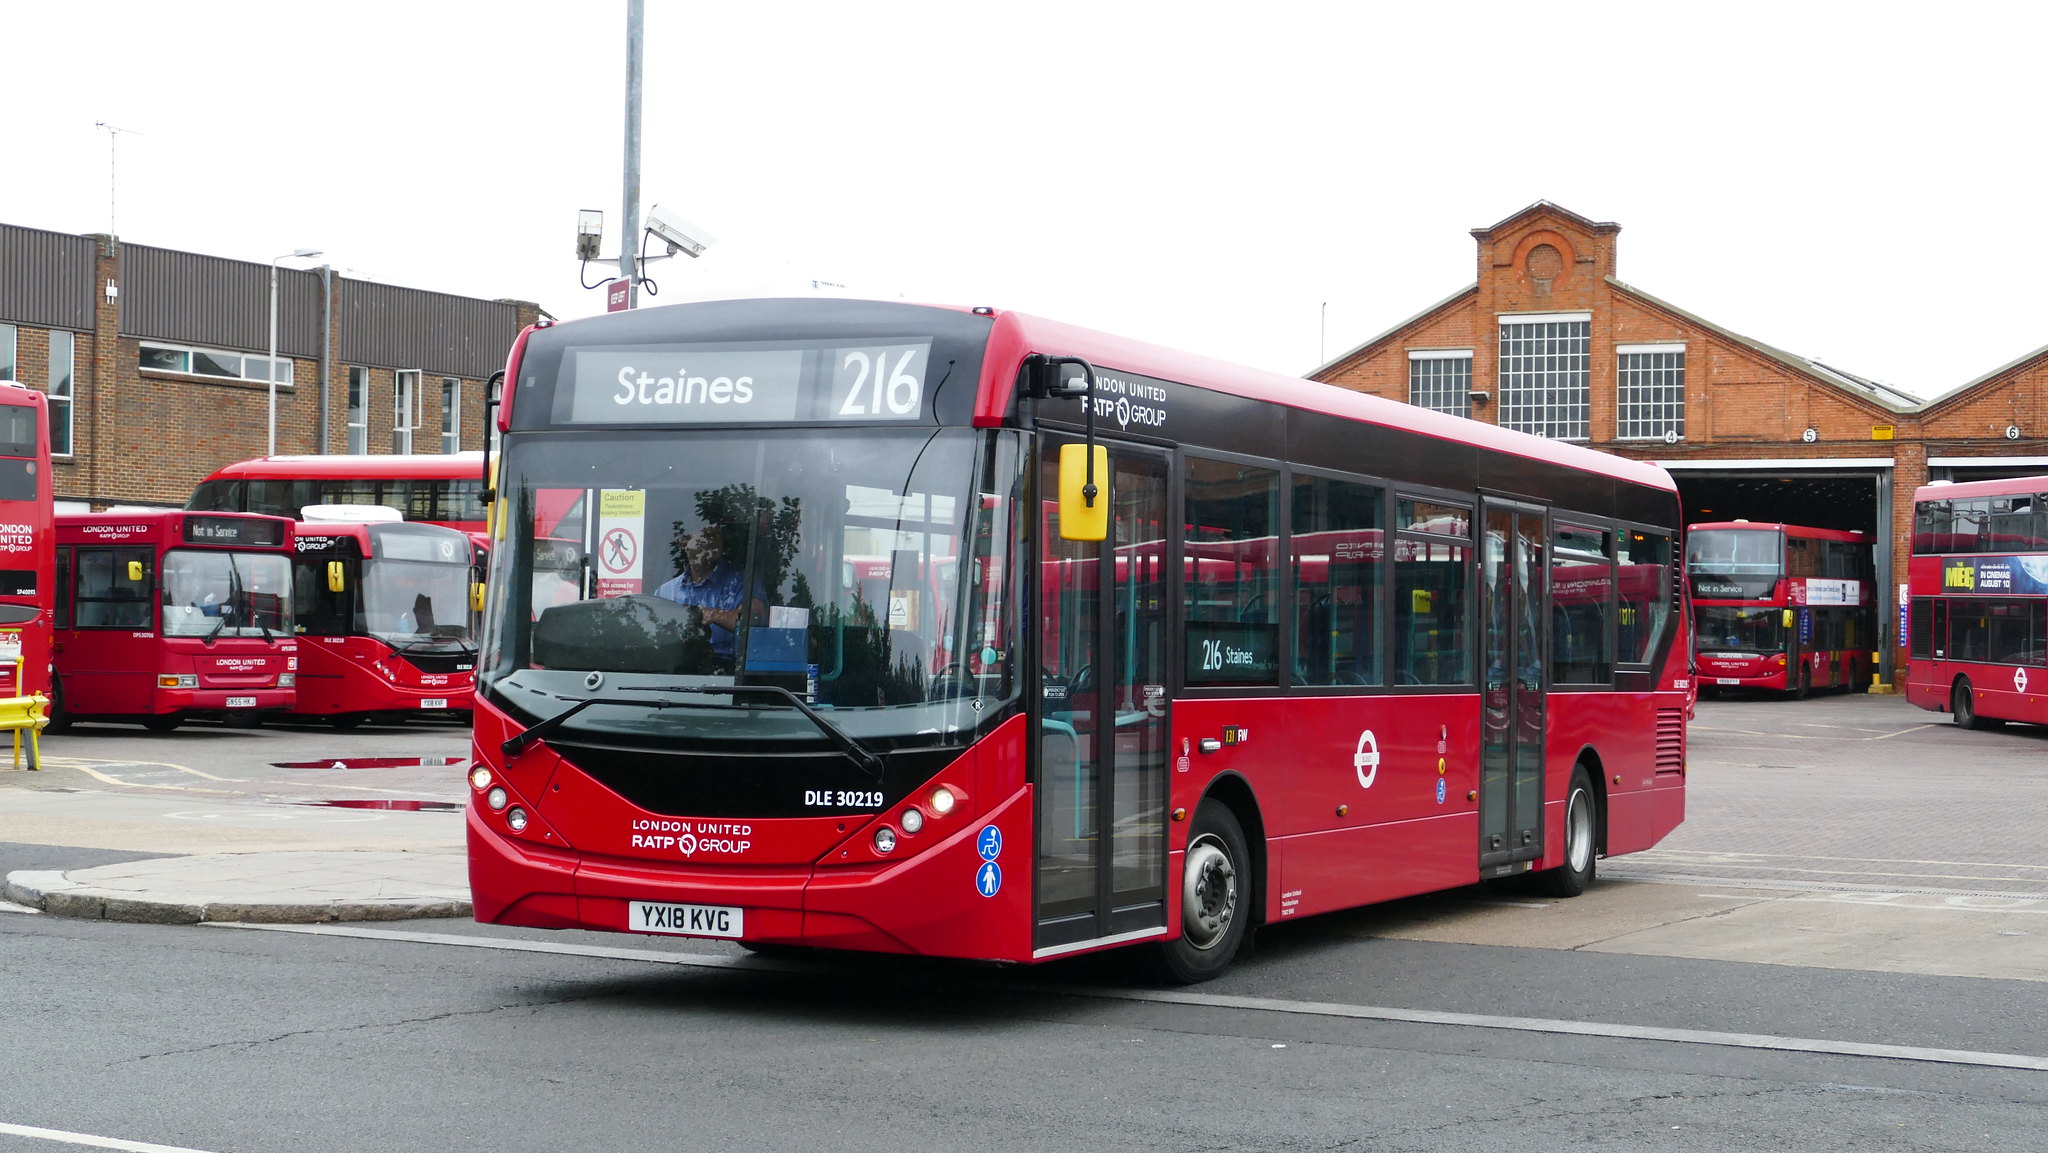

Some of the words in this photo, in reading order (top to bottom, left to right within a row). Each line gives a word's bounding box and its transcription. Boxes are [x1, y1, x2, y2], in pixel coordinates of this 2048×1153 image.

[613, 366, 754, 406] Staines
[838, 350, 921, 416] 216
[1130, 382, 1166, 402] UNITED
[1131, 405, 1166, 427] GROUP
[604, 493, 635, 502] Caution
[0, 524, 32, 534] ONDON
[116, 525, 148, 533] UNITED
[192, 524, 205, 537] Not
[207, 526, 213, 537] in
[215, 525, 238, 538] Service
[0, 535, 32, 544] NITED
[1945, 567, 1975, 591] MEG
[1980, 571, 1986, 579] IN
[1986, 571, 2010, 579] CINEMAS
[1698, 584, 1711, 592] Not
[1720, 584, 1743, 593] Service
[1980, 579, 2002, 588] AUGUST
[2002, 579, 2010, 588] 10
[1203, 639, 1222, 671] 216
[1226, 646, 1254, 664] Staines
[1225, 729, 1235, 743] 131
[1237, 728, 1249, 742] FW
[804, 790, 833, 806] DLE
[836, 790, 884, 807] 30219
[632, 819, 691, 833] LONDON
[697, 823, 752, 836] UNITED
[632, 834, 675, 849] RATP
[698, 838, 751, 854] GROUP
[641, 905, 685, 929] YX18
[690, 908, 730, 932] KVG
